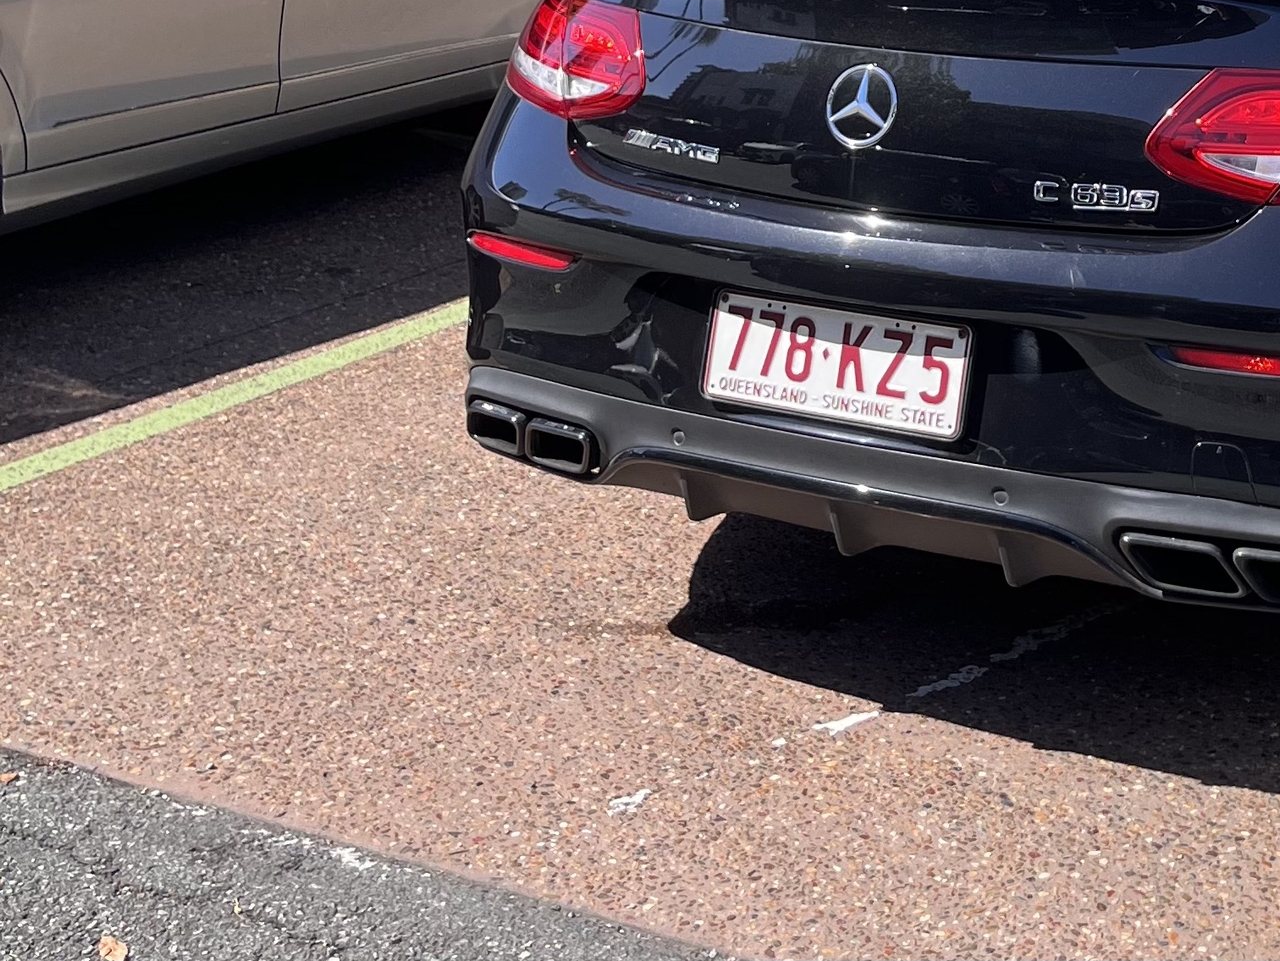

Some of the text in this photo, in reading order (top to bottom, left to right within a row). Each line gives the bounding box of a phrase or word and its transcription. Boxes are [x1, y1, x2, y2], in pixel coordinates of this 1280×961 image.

[651, 134, 720, 164] AMG
[1033, 180, 1060, 203] C
[719, 376, 808, 406] QUEENSLAND
[822, 393, 894, 420] SUNSHINE
[901, 406, 946, 428] STATE
